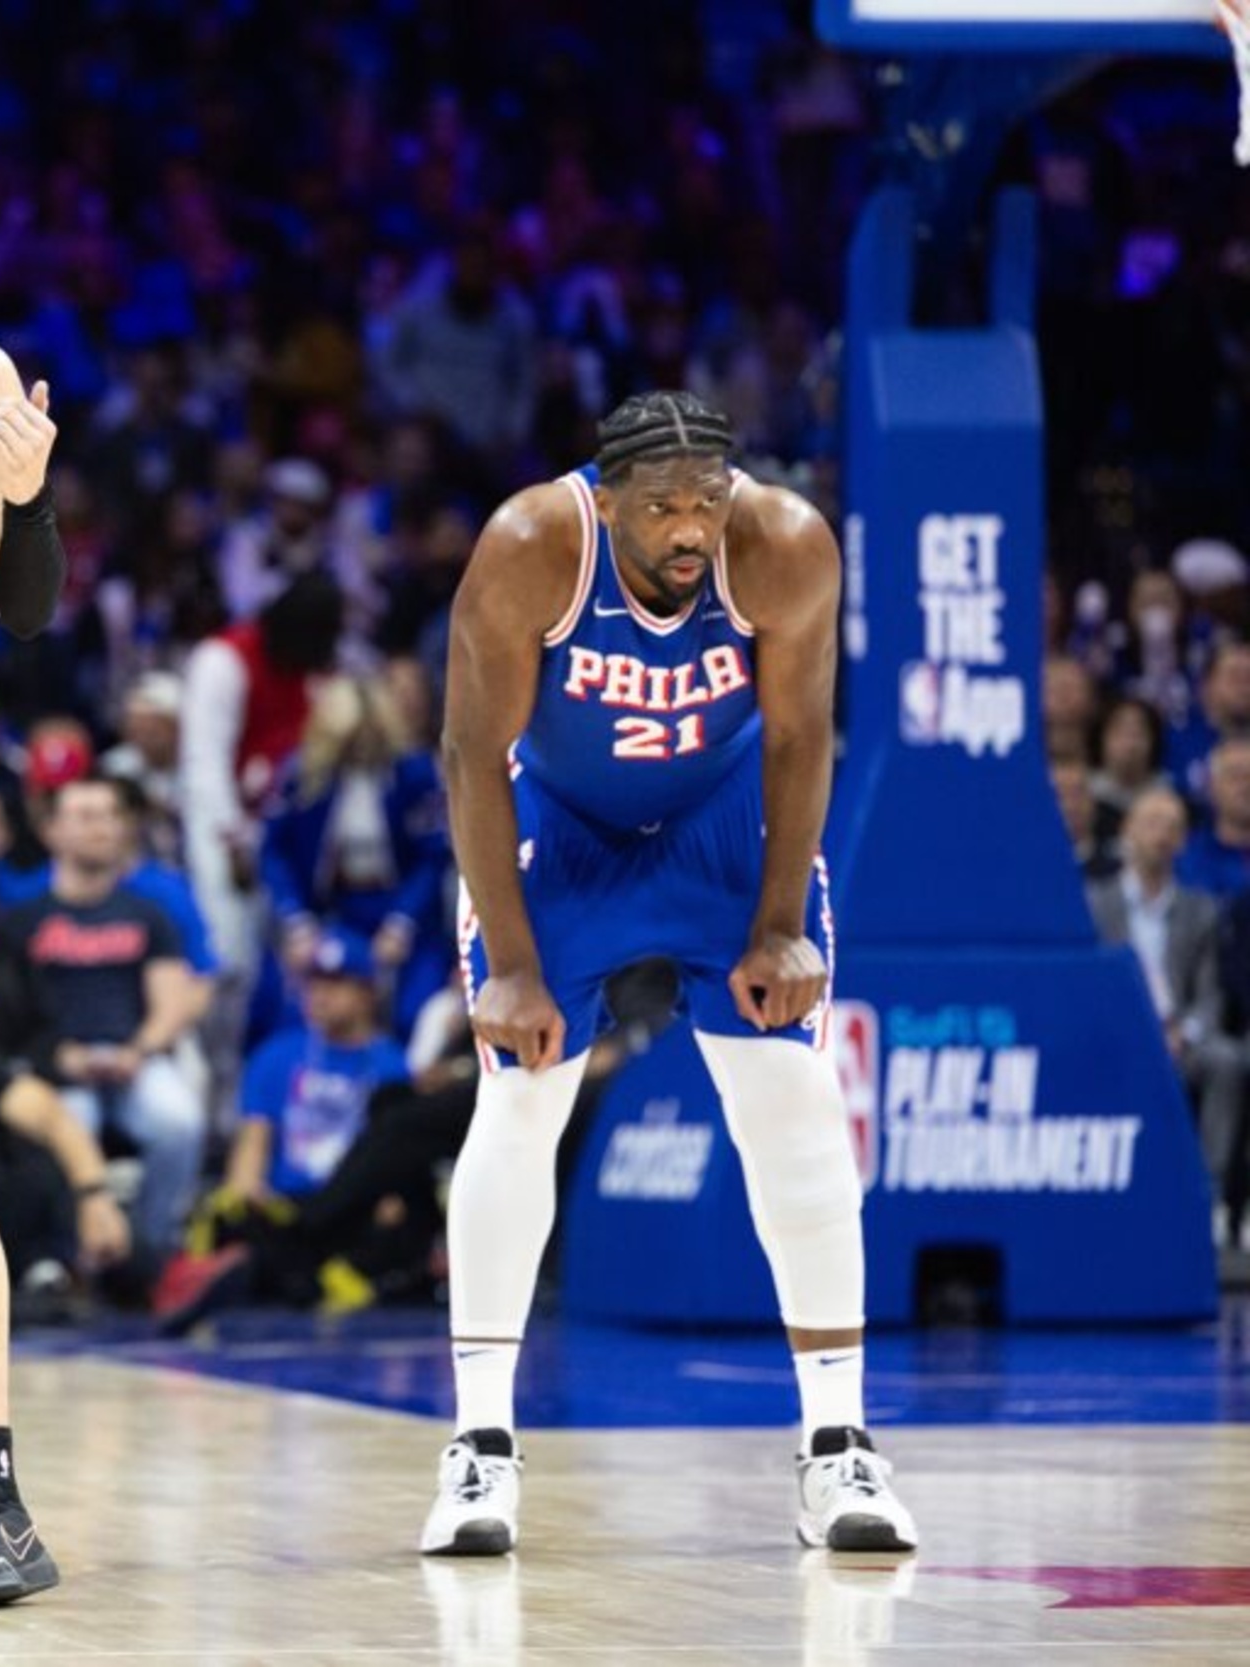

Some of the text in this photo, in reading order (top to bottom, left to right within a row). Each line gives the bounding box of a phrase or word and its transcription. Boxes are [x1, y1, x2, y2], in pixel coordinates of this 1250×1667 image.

[918, 512, 1006, 588] GET
[919, 588, 1006, 664] THE
[563, 644, 749, 713] PHILA
[612, 714, 705, 761] 21
[883, 1046, 1038, 1121] PLAY-IN
[883, 1114, 1142, 1193] TOURNAMENT
